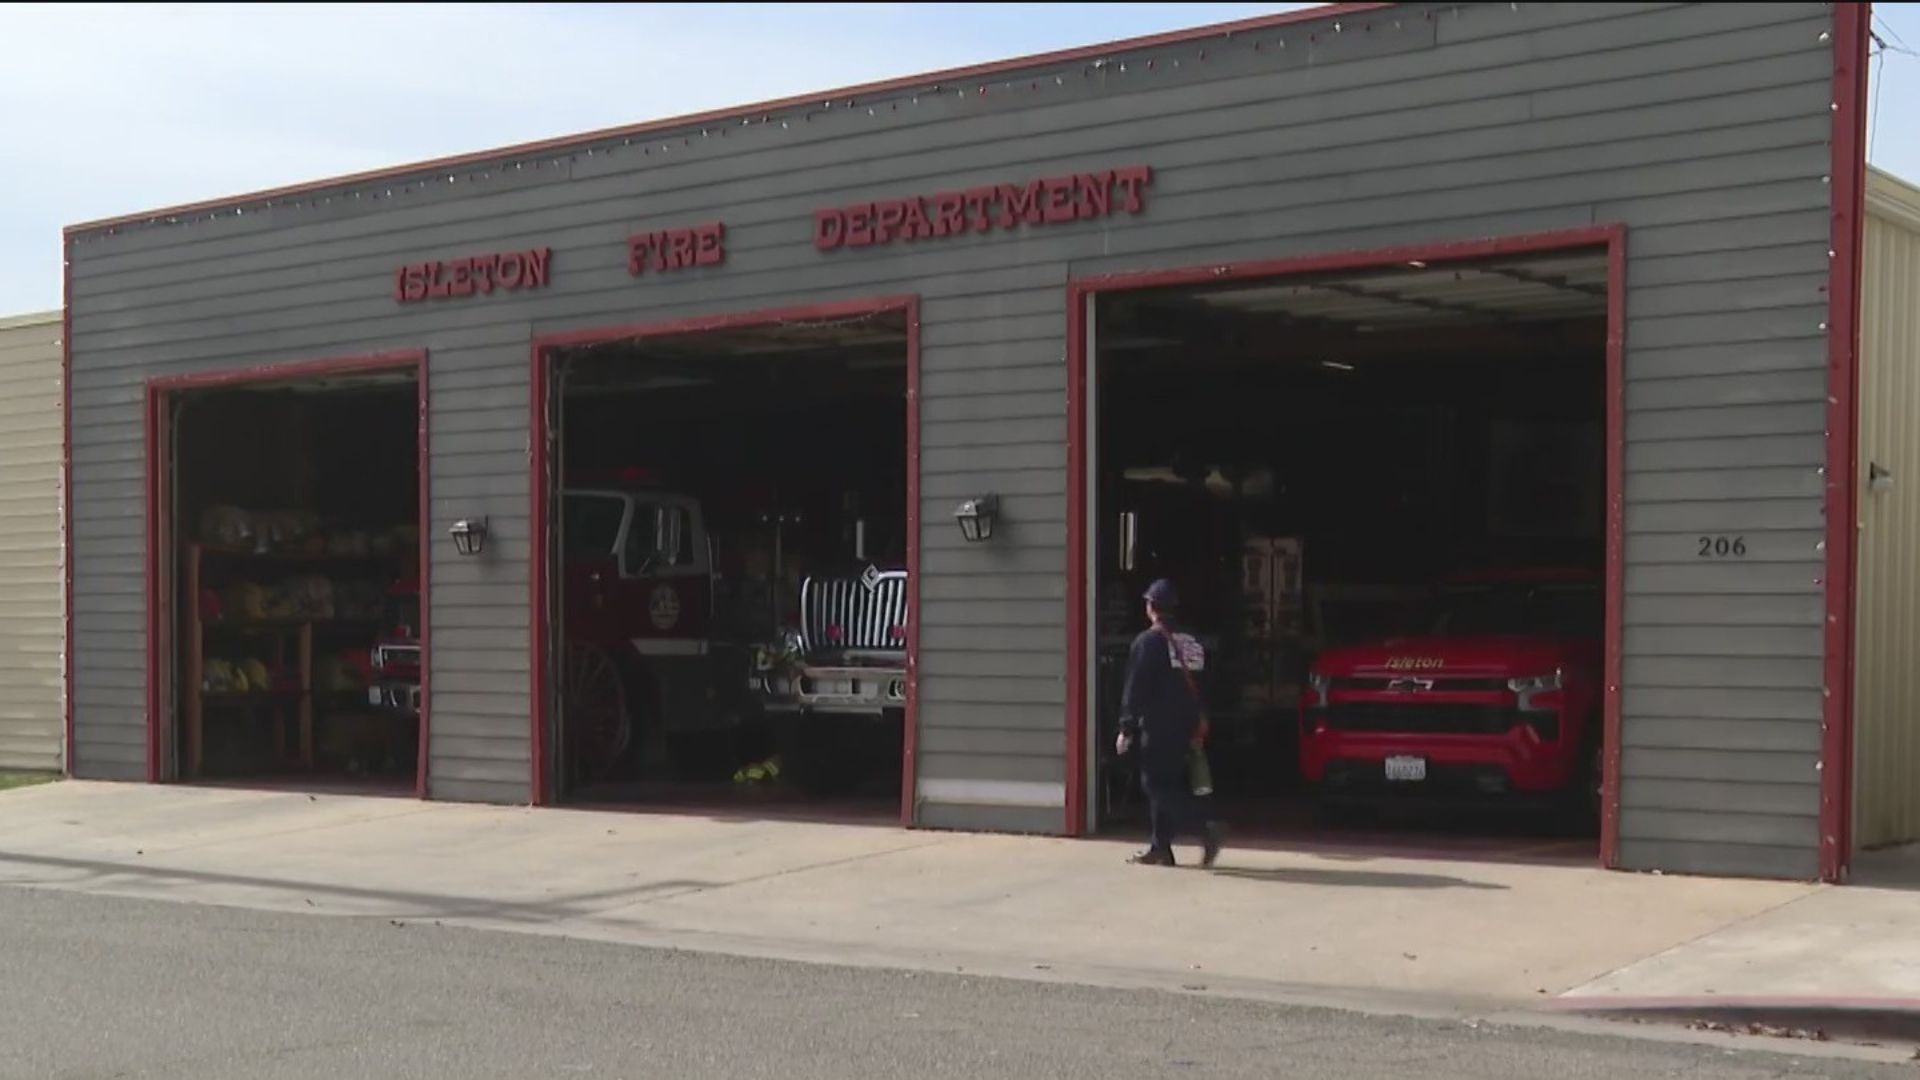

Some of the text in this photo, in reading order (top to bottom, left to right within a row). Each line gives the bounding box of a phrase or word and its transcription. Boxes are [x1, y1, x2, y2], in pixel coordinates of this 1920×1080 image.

[395, 166, 1153, 303] ISLETON FIRE DEPARTMENT
[1698, 536, 1746, 556] 206
